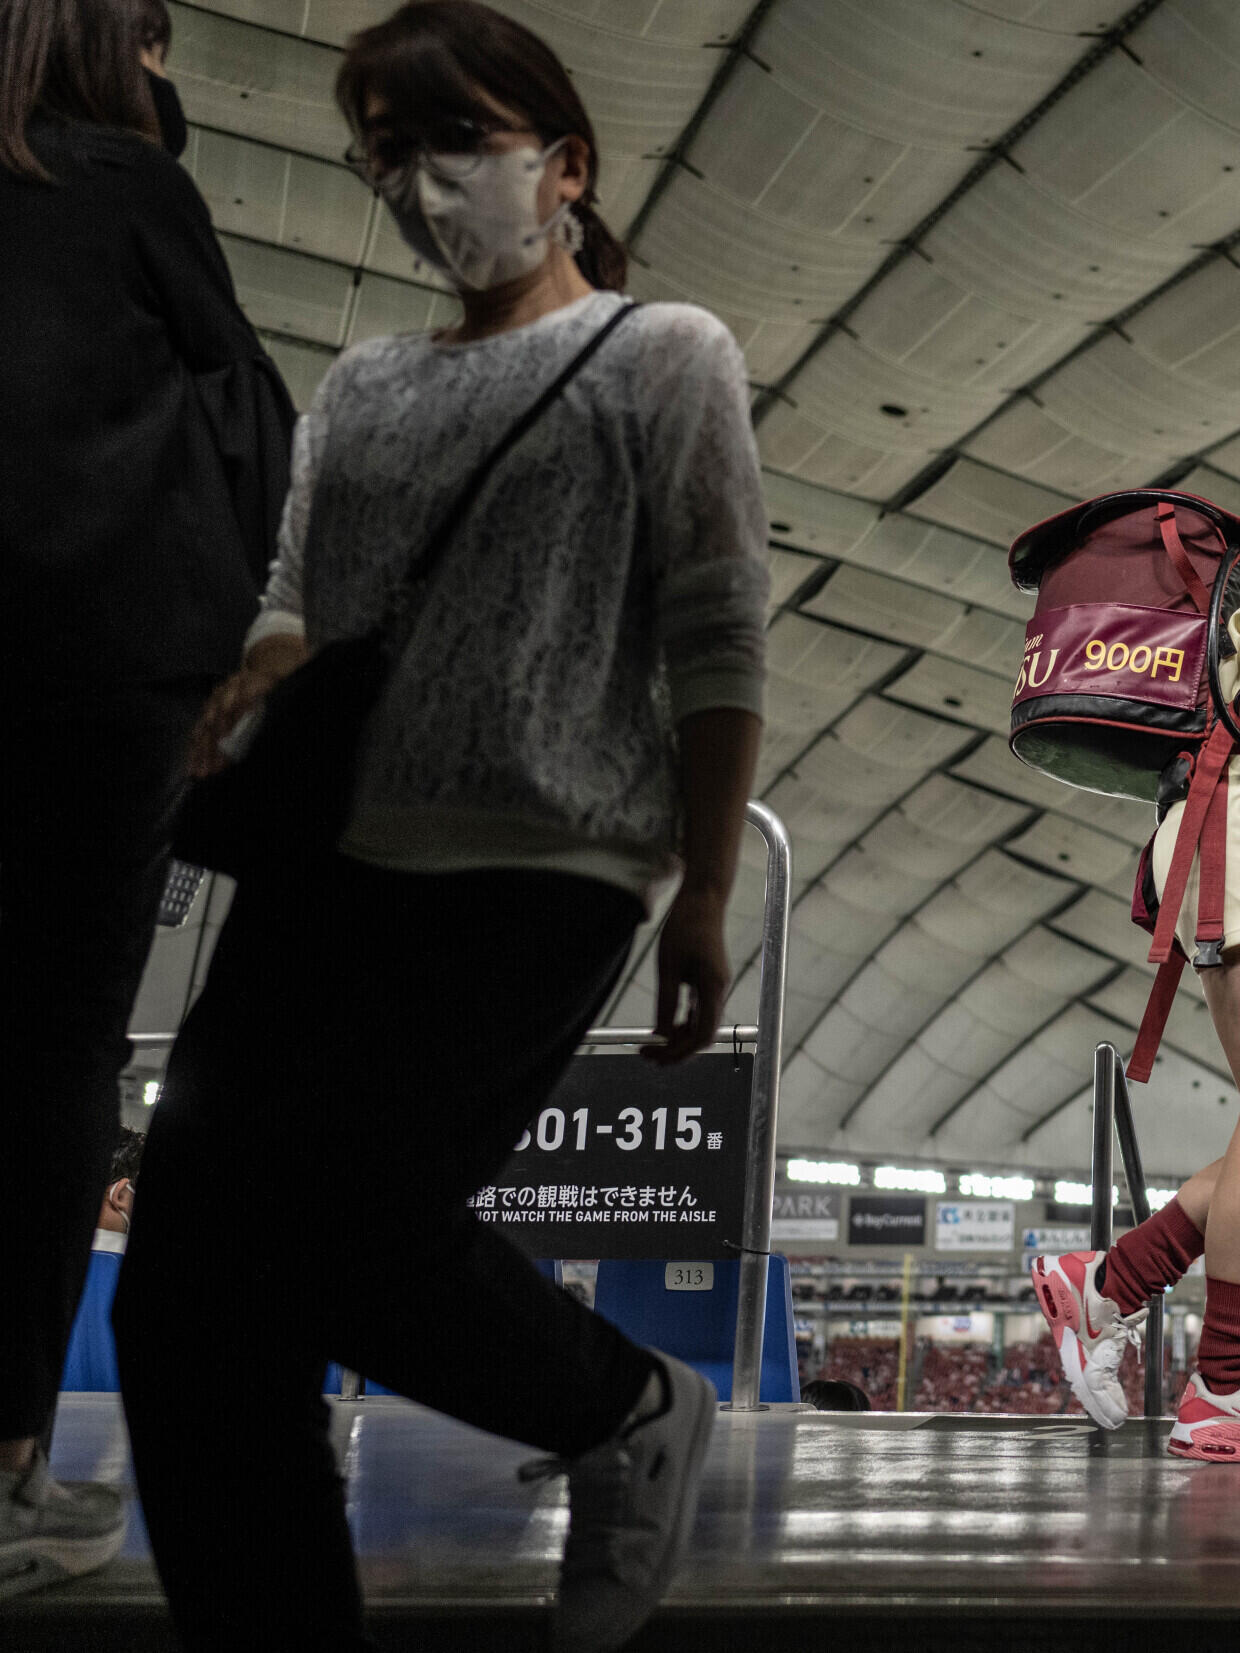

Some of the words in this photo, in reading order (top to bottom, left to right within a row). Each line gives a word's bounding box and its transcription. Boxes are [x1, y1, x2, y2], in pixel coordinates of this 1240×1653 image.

[1084, 640, 1185, 682] 900円
[514, 1107, 723, 1151] 01-315番
[466, 1185, 698, 1208] 路での観戦はできません
[502, 1211, 545, 1222] WATCH
[548, 1211, 572, 1222] THE
[575, 1211, 611, 1222] GAME
[614, 1211, 649, 1222] FROM
[652, 1211, 677, 1222] THE
[679, 1211, 716, 1222] AISLE
[674, 1269, 704, 1285] 313
